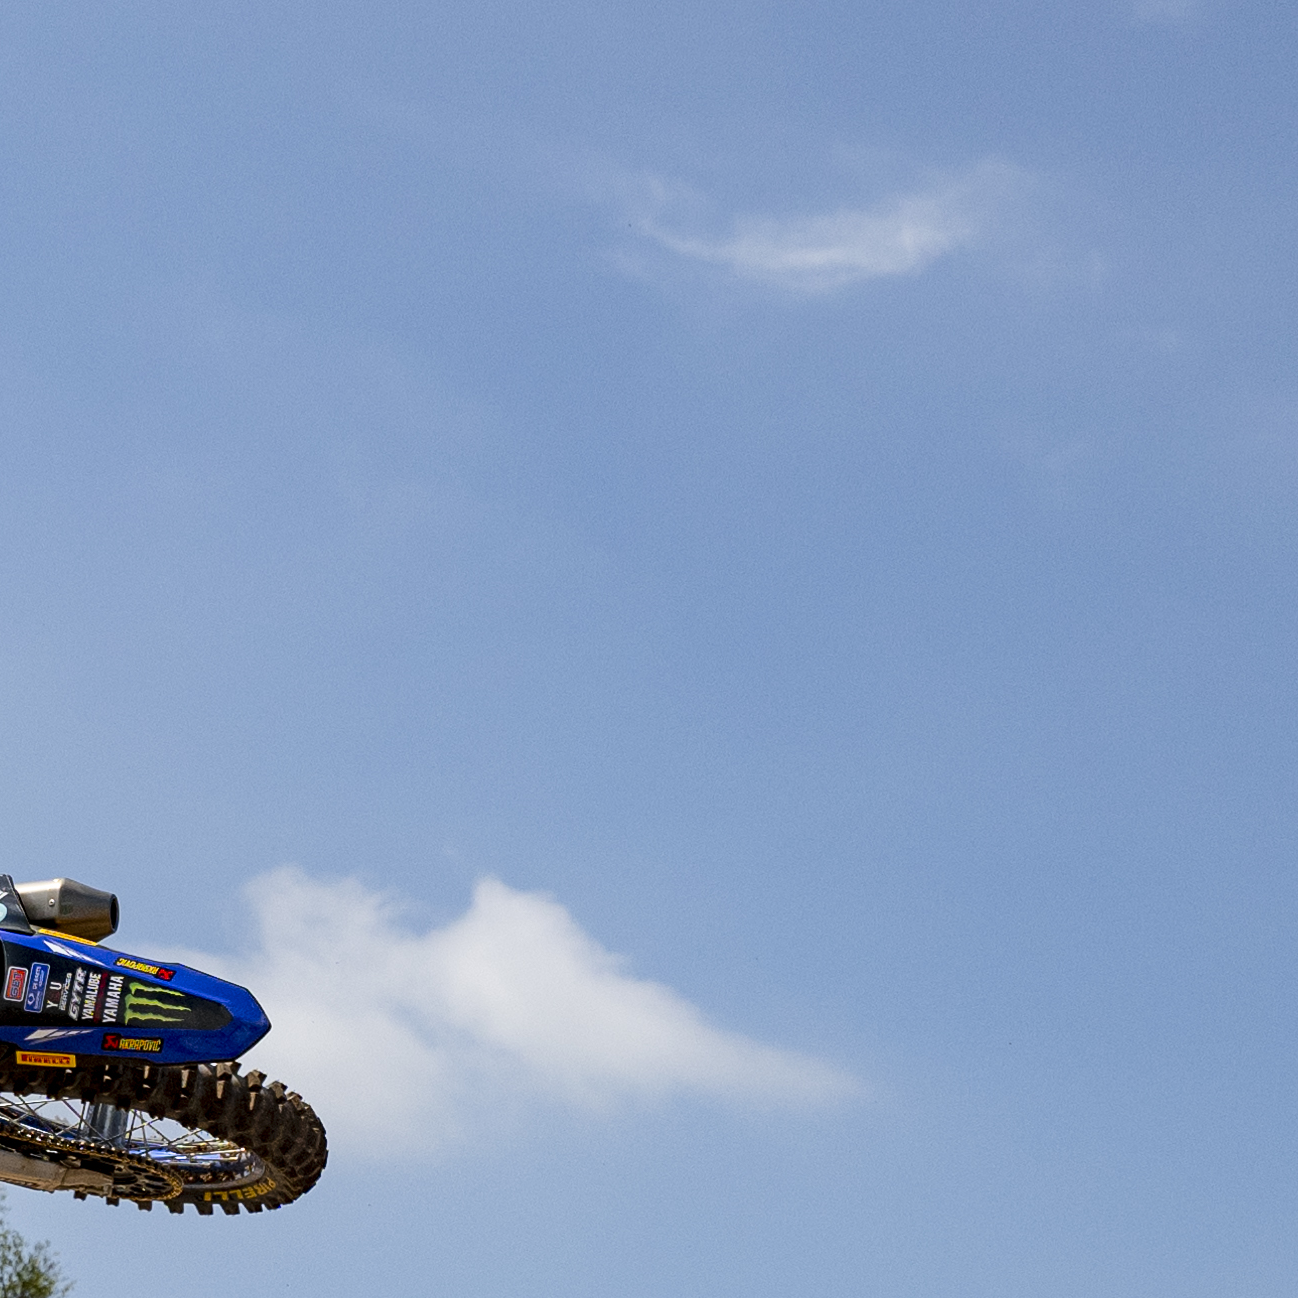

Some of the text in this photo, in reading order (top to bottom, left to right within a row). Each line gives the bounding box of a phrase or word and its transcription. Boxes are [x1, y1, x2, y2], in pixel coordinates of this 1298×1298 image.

[68, 967, 88, 1021] GYTR
[81, 972, 102, 1020] YAMALUBE
[102, 975, 125, 1023] YAMAHA
[204, 1177, 277, 1202] PIRELLI
